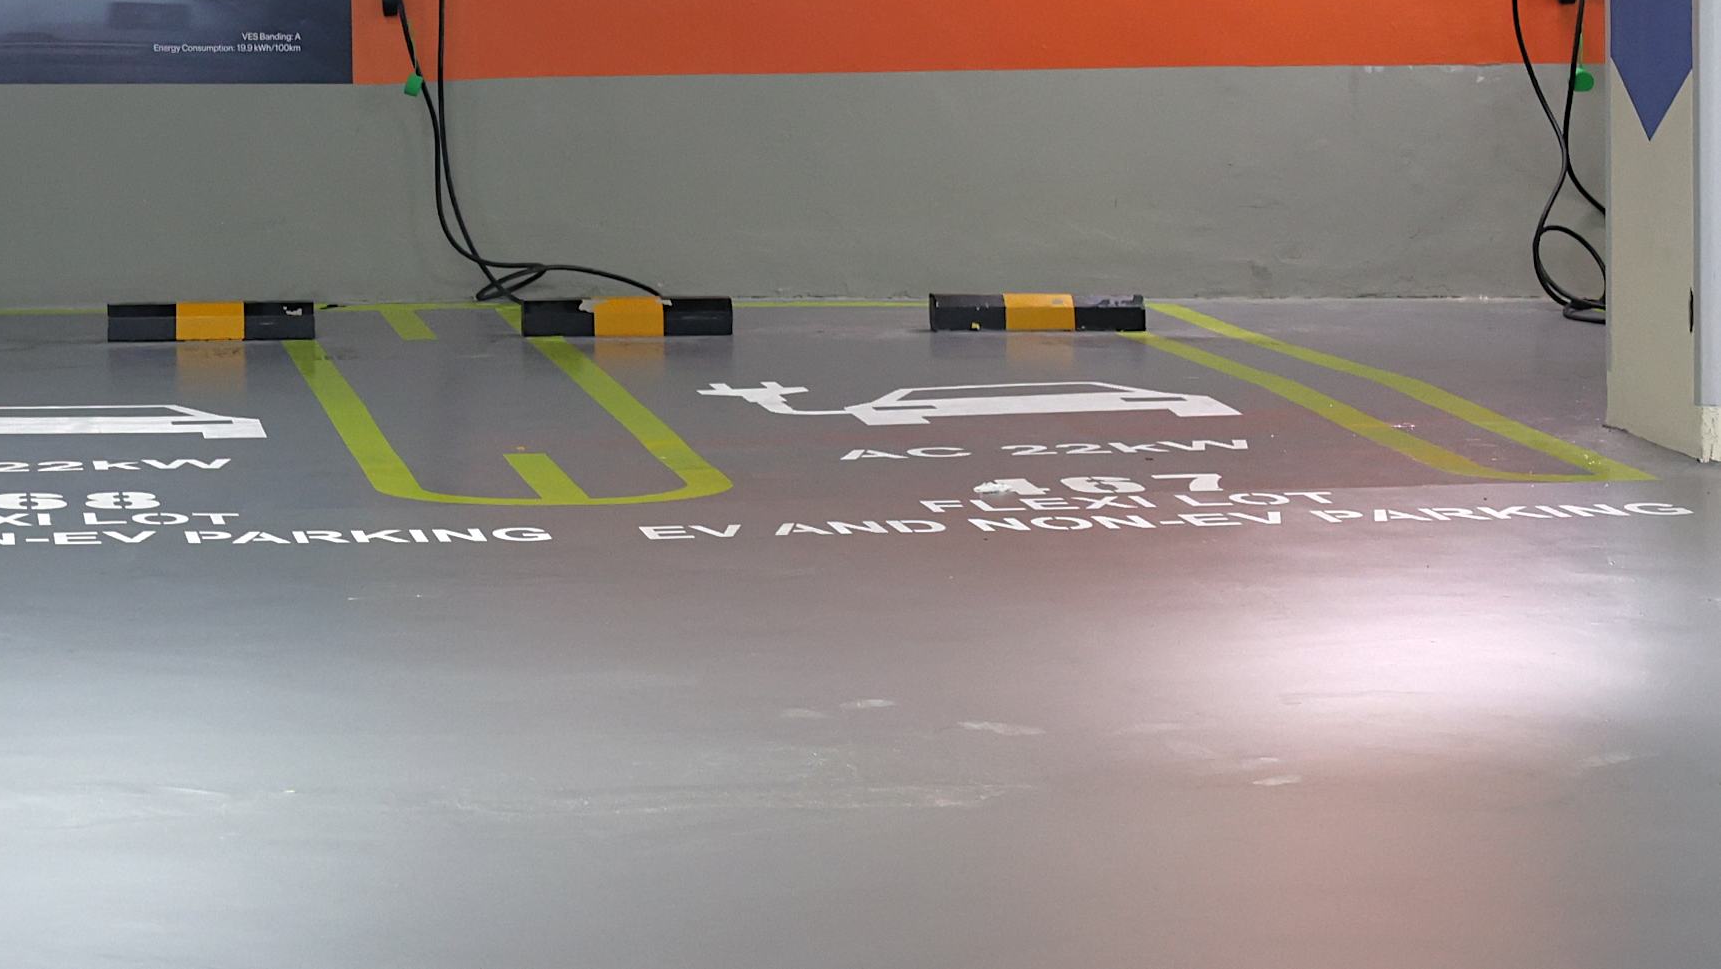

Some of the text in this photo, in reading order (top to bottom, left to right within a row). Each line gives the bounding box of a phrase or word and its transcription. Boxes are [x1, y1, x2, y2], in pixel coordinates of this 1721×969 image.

[242, 32, 301, 42] VES Banding: A
[153, 44, 301, 53] Energy Consumption: 19.9 kWh/100km
[840, 438, 1249, 460] AC 22kW
[974, 472, 1224, 496] 467
[919, 491, 1334, 513] FLEXI LOT
[82, 512, 240, 526] LOT
[639, 502, 1694, 540] EV AND NON-EV PARKING
[184, 526, 552, 544] PARKING
